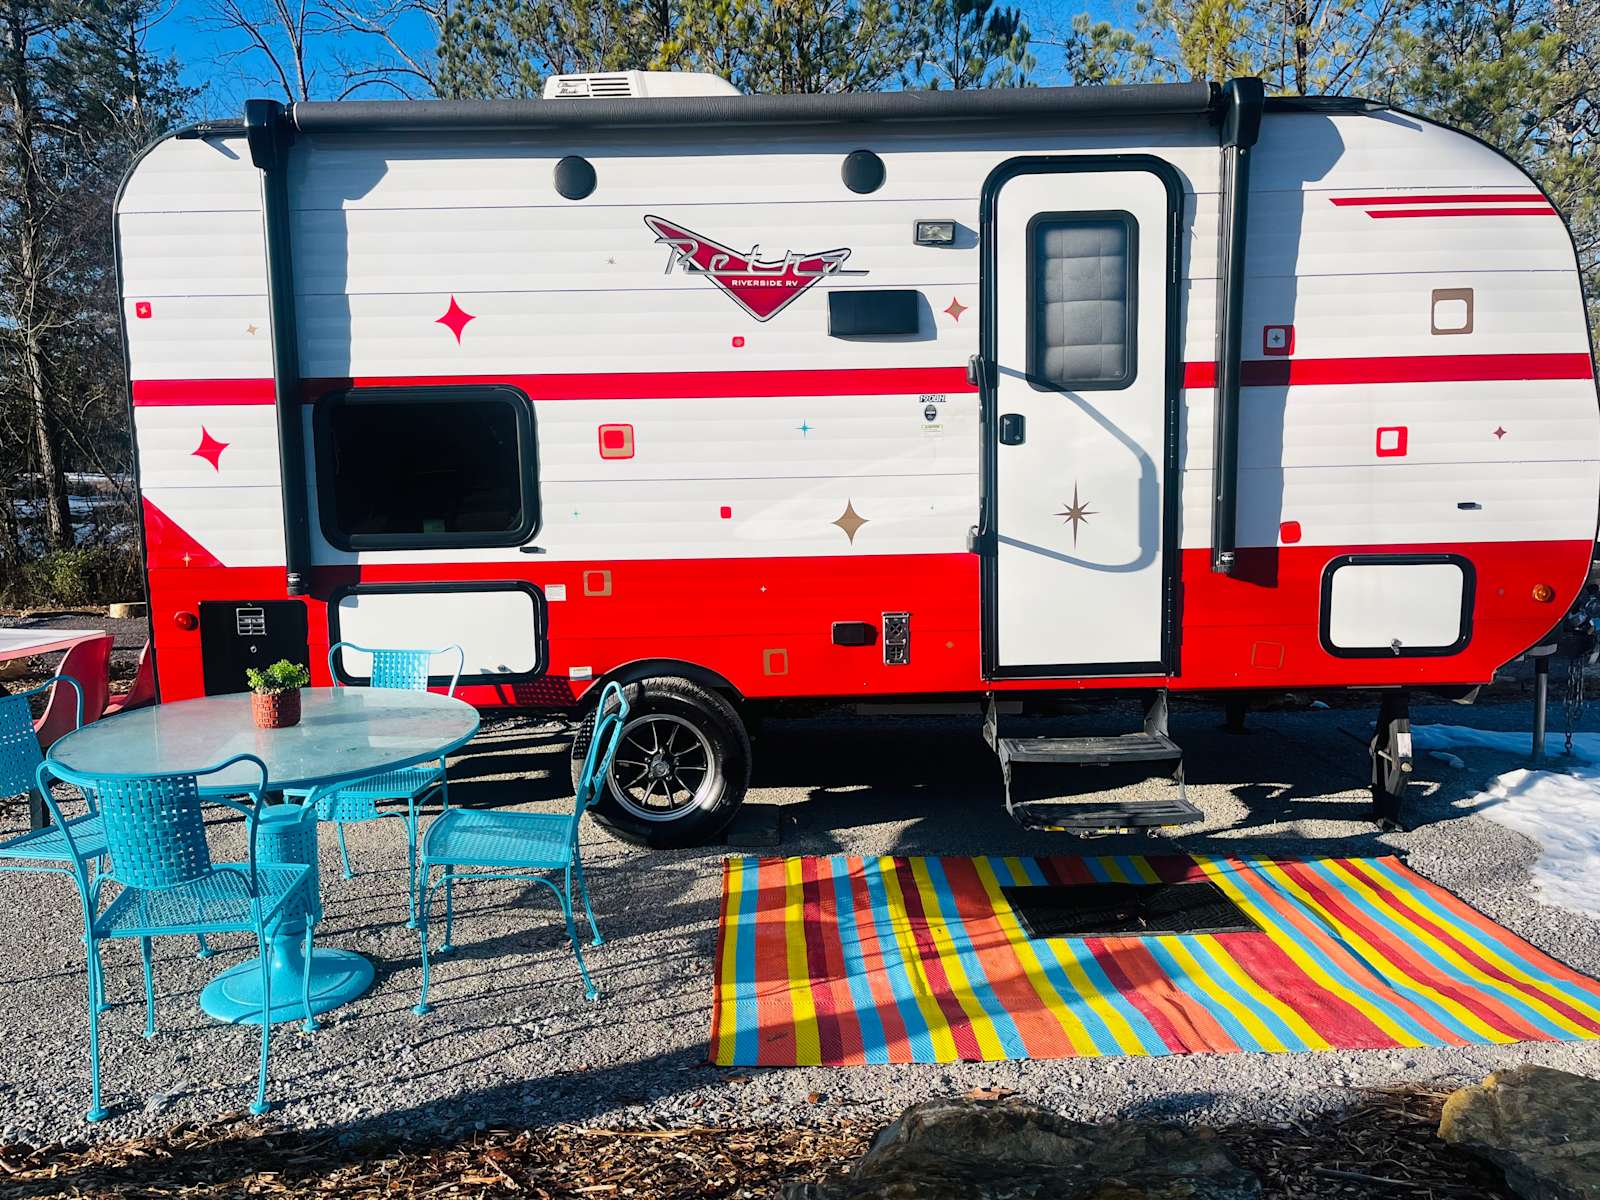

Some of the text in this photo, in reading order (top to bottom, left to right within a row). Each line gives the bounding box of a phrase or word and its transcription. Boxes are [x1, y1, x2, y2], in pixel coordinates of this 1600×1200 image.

[655, 238, 870, 275] Retro
[731, 279, 799, 287] RIVERSIDE RV
